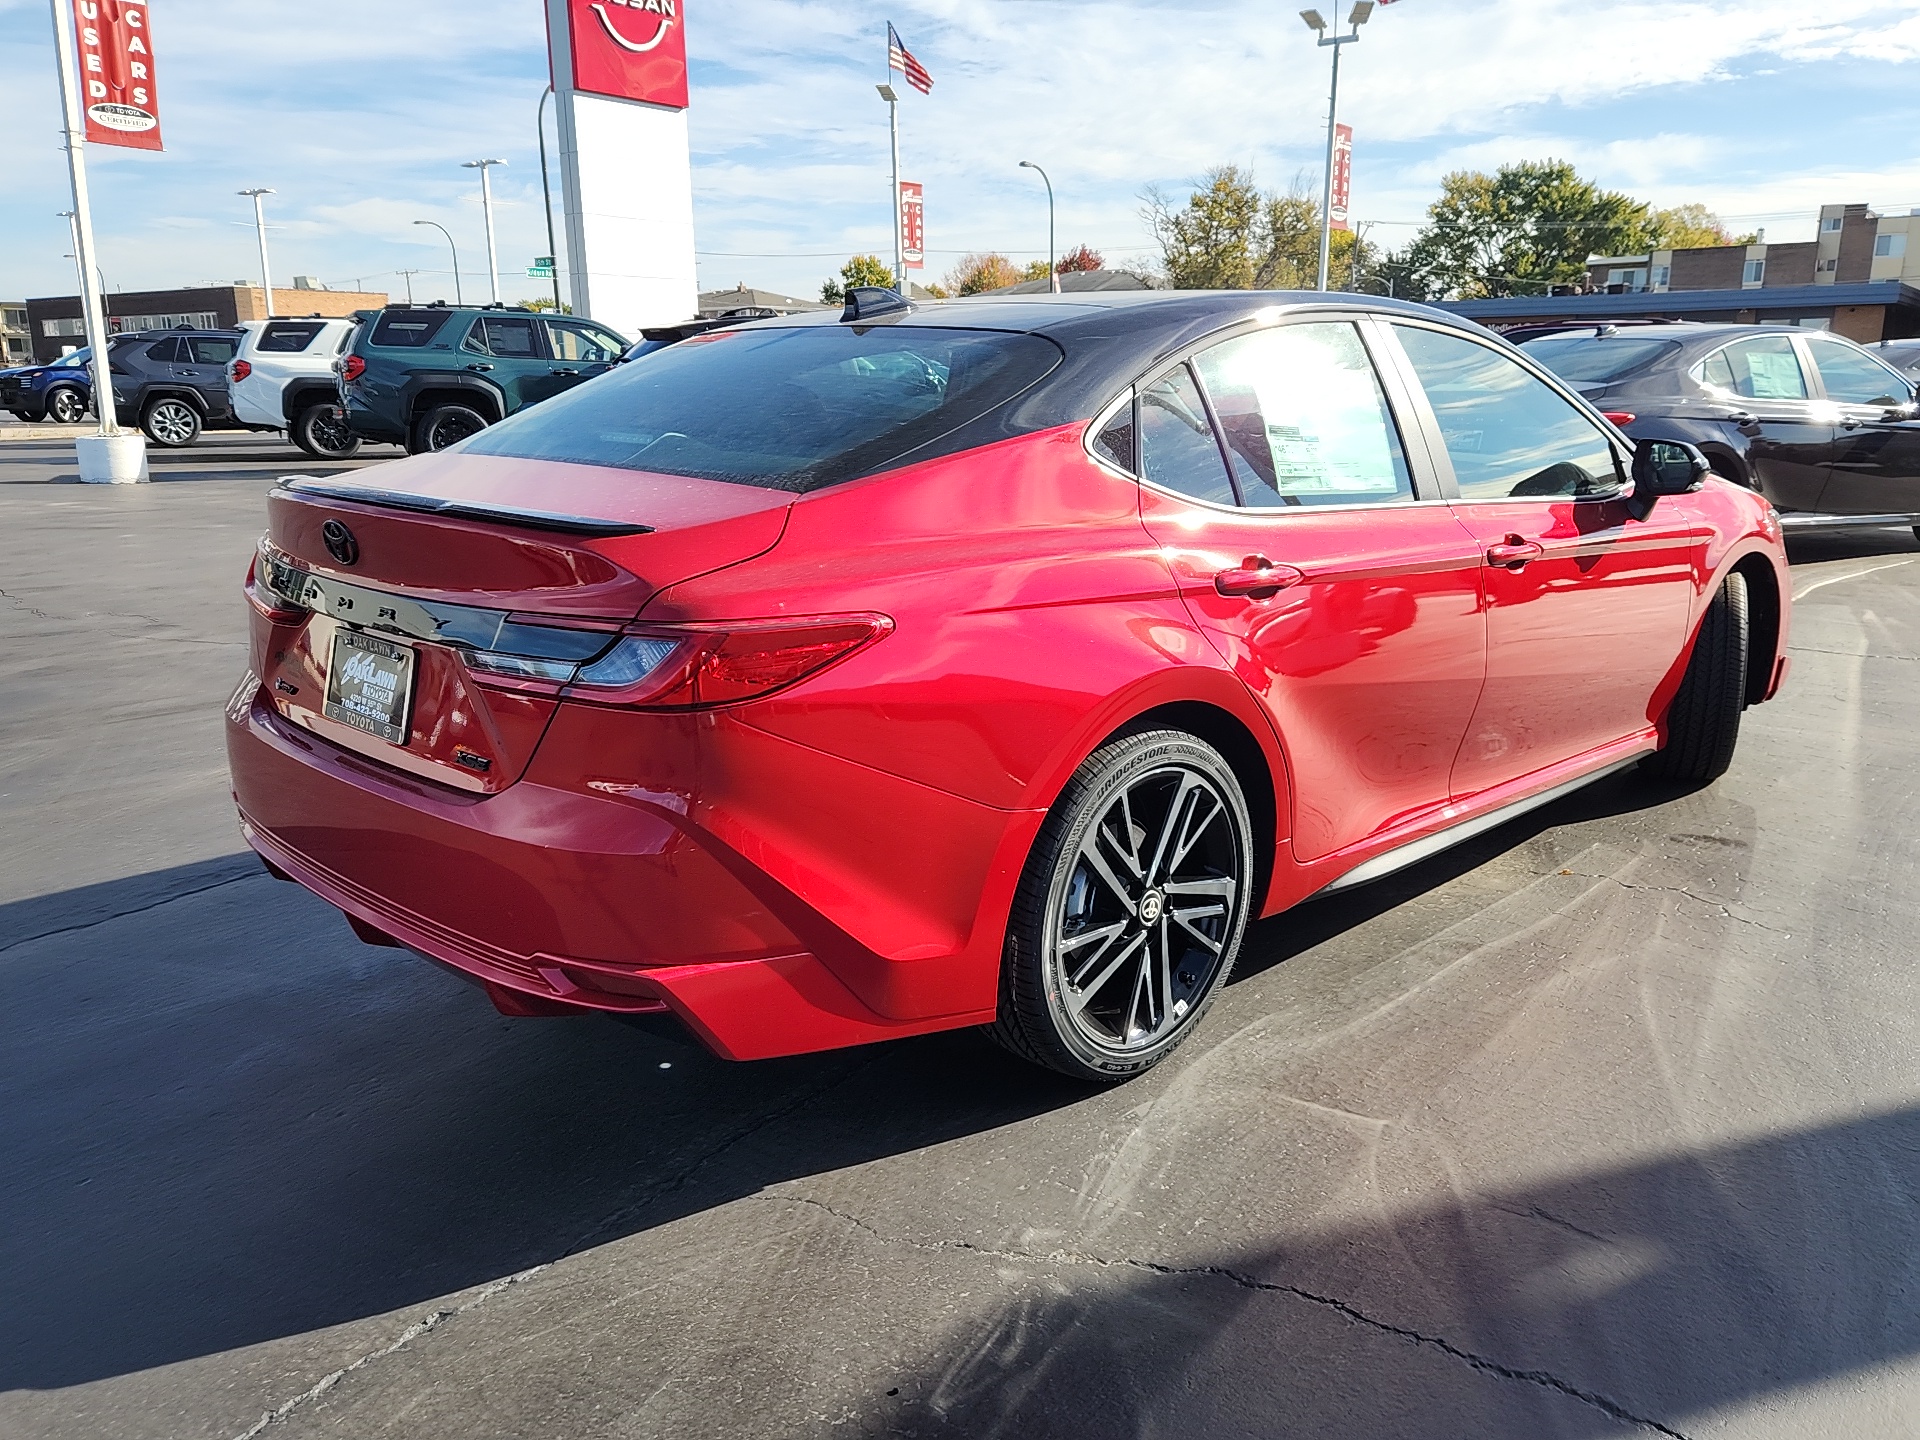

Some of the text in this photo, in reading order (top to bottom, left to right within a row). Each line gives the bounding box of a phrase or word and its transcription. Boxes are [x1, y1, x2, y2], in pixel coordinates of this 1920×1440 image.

[604, 0, 676, 17] SAN
[80, 0, 107, 98] USED
[125, 9, 149, 105] CARS
[116, 108, 142, 117] TOYOTA
[1332, 152, 1340, 204] USED
[1342, 153, 1350, 206] CARS
[902, 204, 910, 248] USED
[353, 637, 391, 656] OAK LAWN
[362, 697, 368, 705] W
[366, 685, 391, 702] TOYOTA
[341, 698, 391, 723] 708-423-5200
[346, 711, 375, 732] TOYOTA
[456, 750, 492, 772] XSE
[1096, 745, 1170, 801] BRIDGESTONE
[1145, 1010, 1208, 1066] TURANZA
